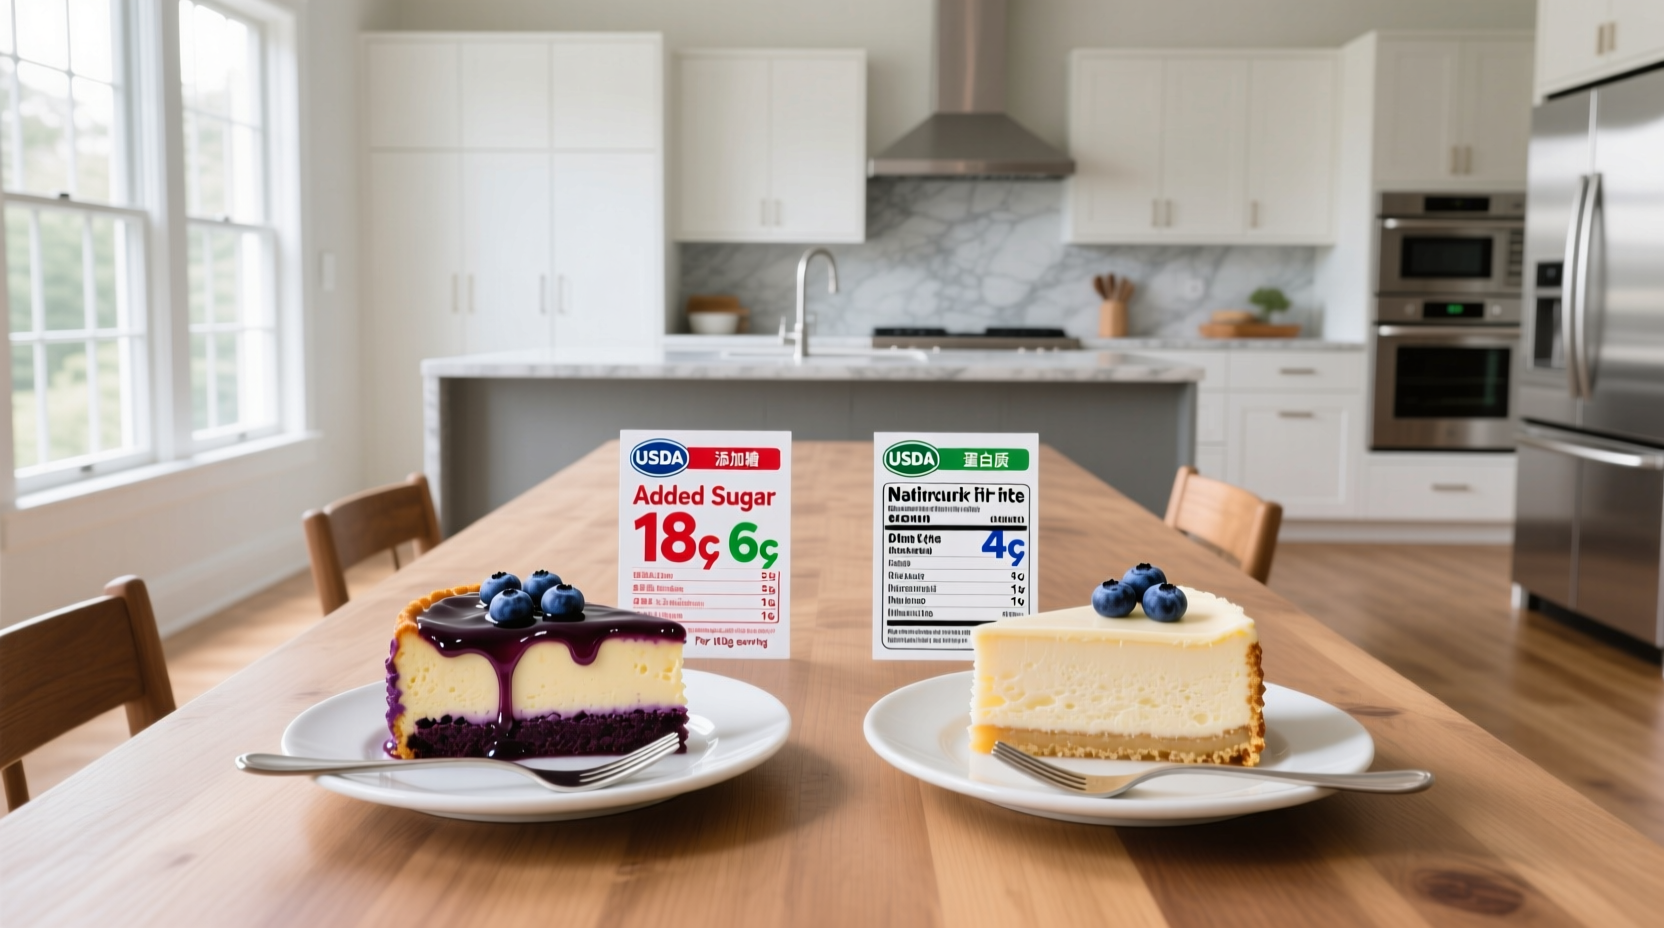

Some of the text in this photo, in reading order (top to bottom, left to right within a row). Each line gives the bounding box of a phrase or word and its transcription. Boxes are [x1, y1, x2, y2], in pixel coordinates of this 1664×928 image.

[635, 450, 684, 466] USDA
[889, 451, 935, 467] USDA
[633, 484, 776, 512] Added Sugar
